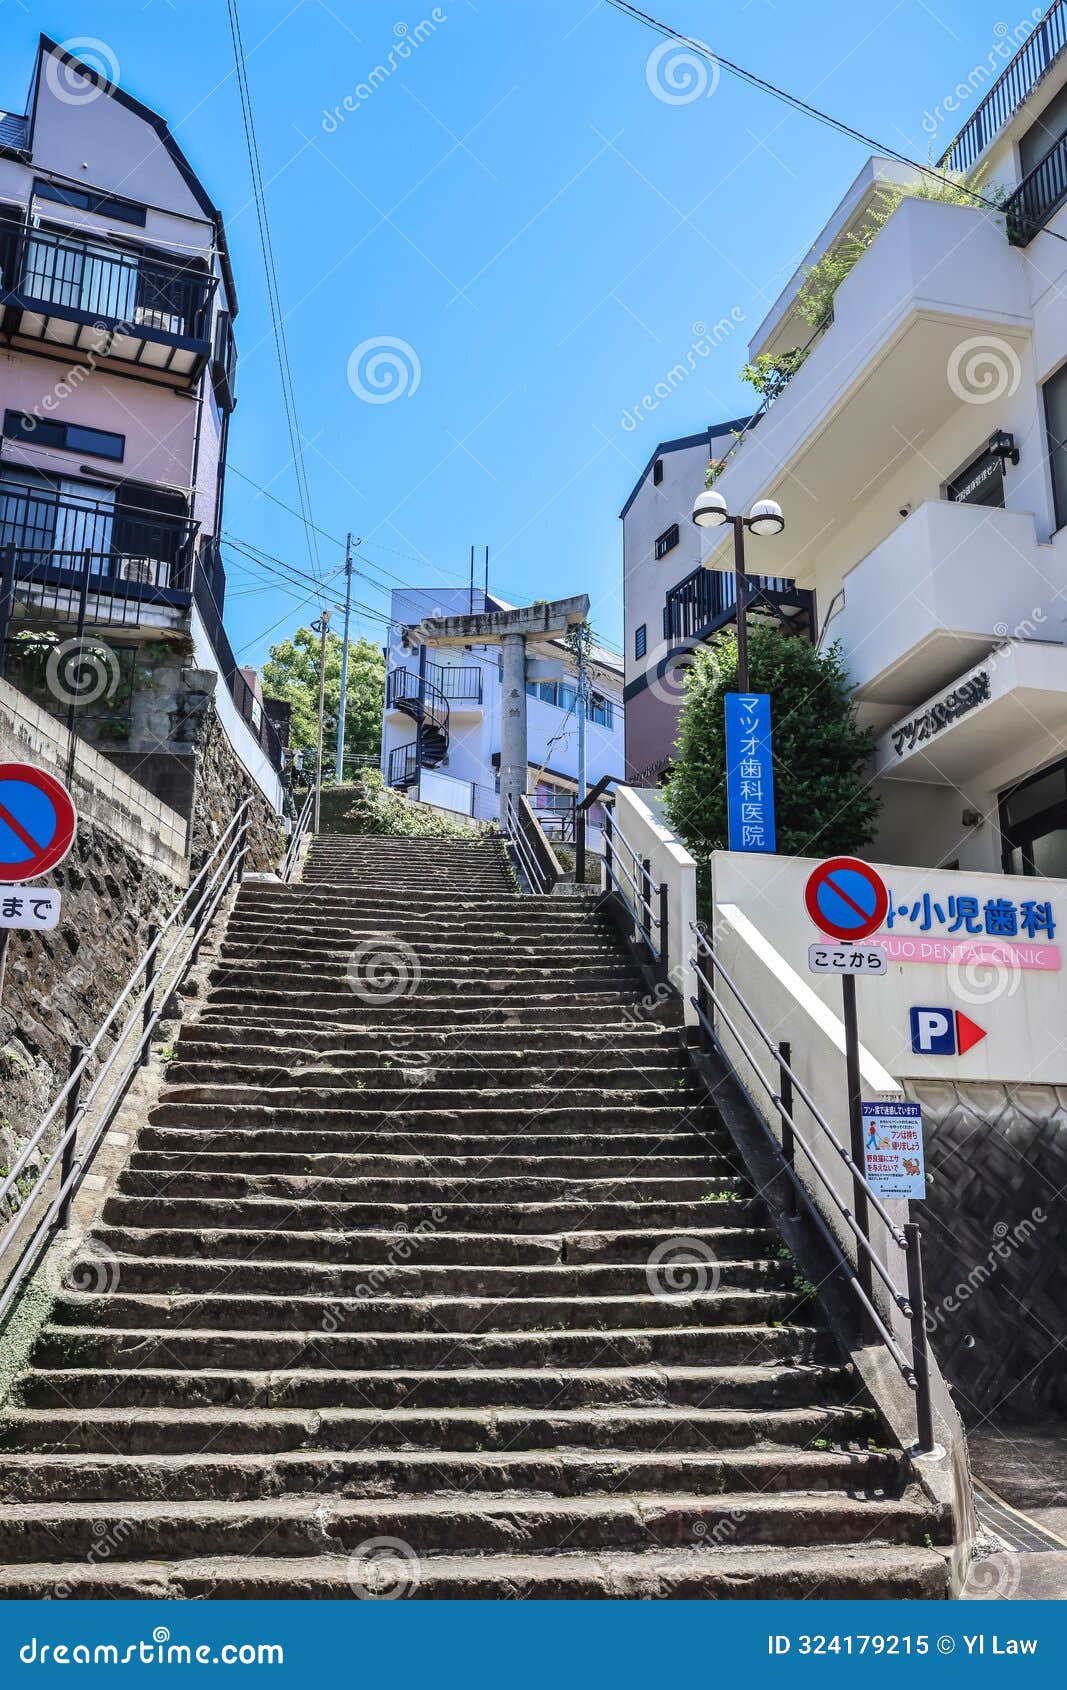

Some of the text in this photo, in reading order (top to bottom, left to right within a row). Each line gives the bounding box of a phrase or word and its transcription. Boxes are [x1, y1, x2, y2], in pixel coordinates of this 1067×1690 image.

[738, 697, 765, 847] マツオ歯科医院
[2, 896, 53, 921] まで
[887, 889, 1056, 940] ・小児歯科
[815, 951, 882, 968] ここから
[921, 943, 987, 961] DENTAL
[991, 948, 1047, 965] CLINIC
[918, 1011, 949, 1050] P
